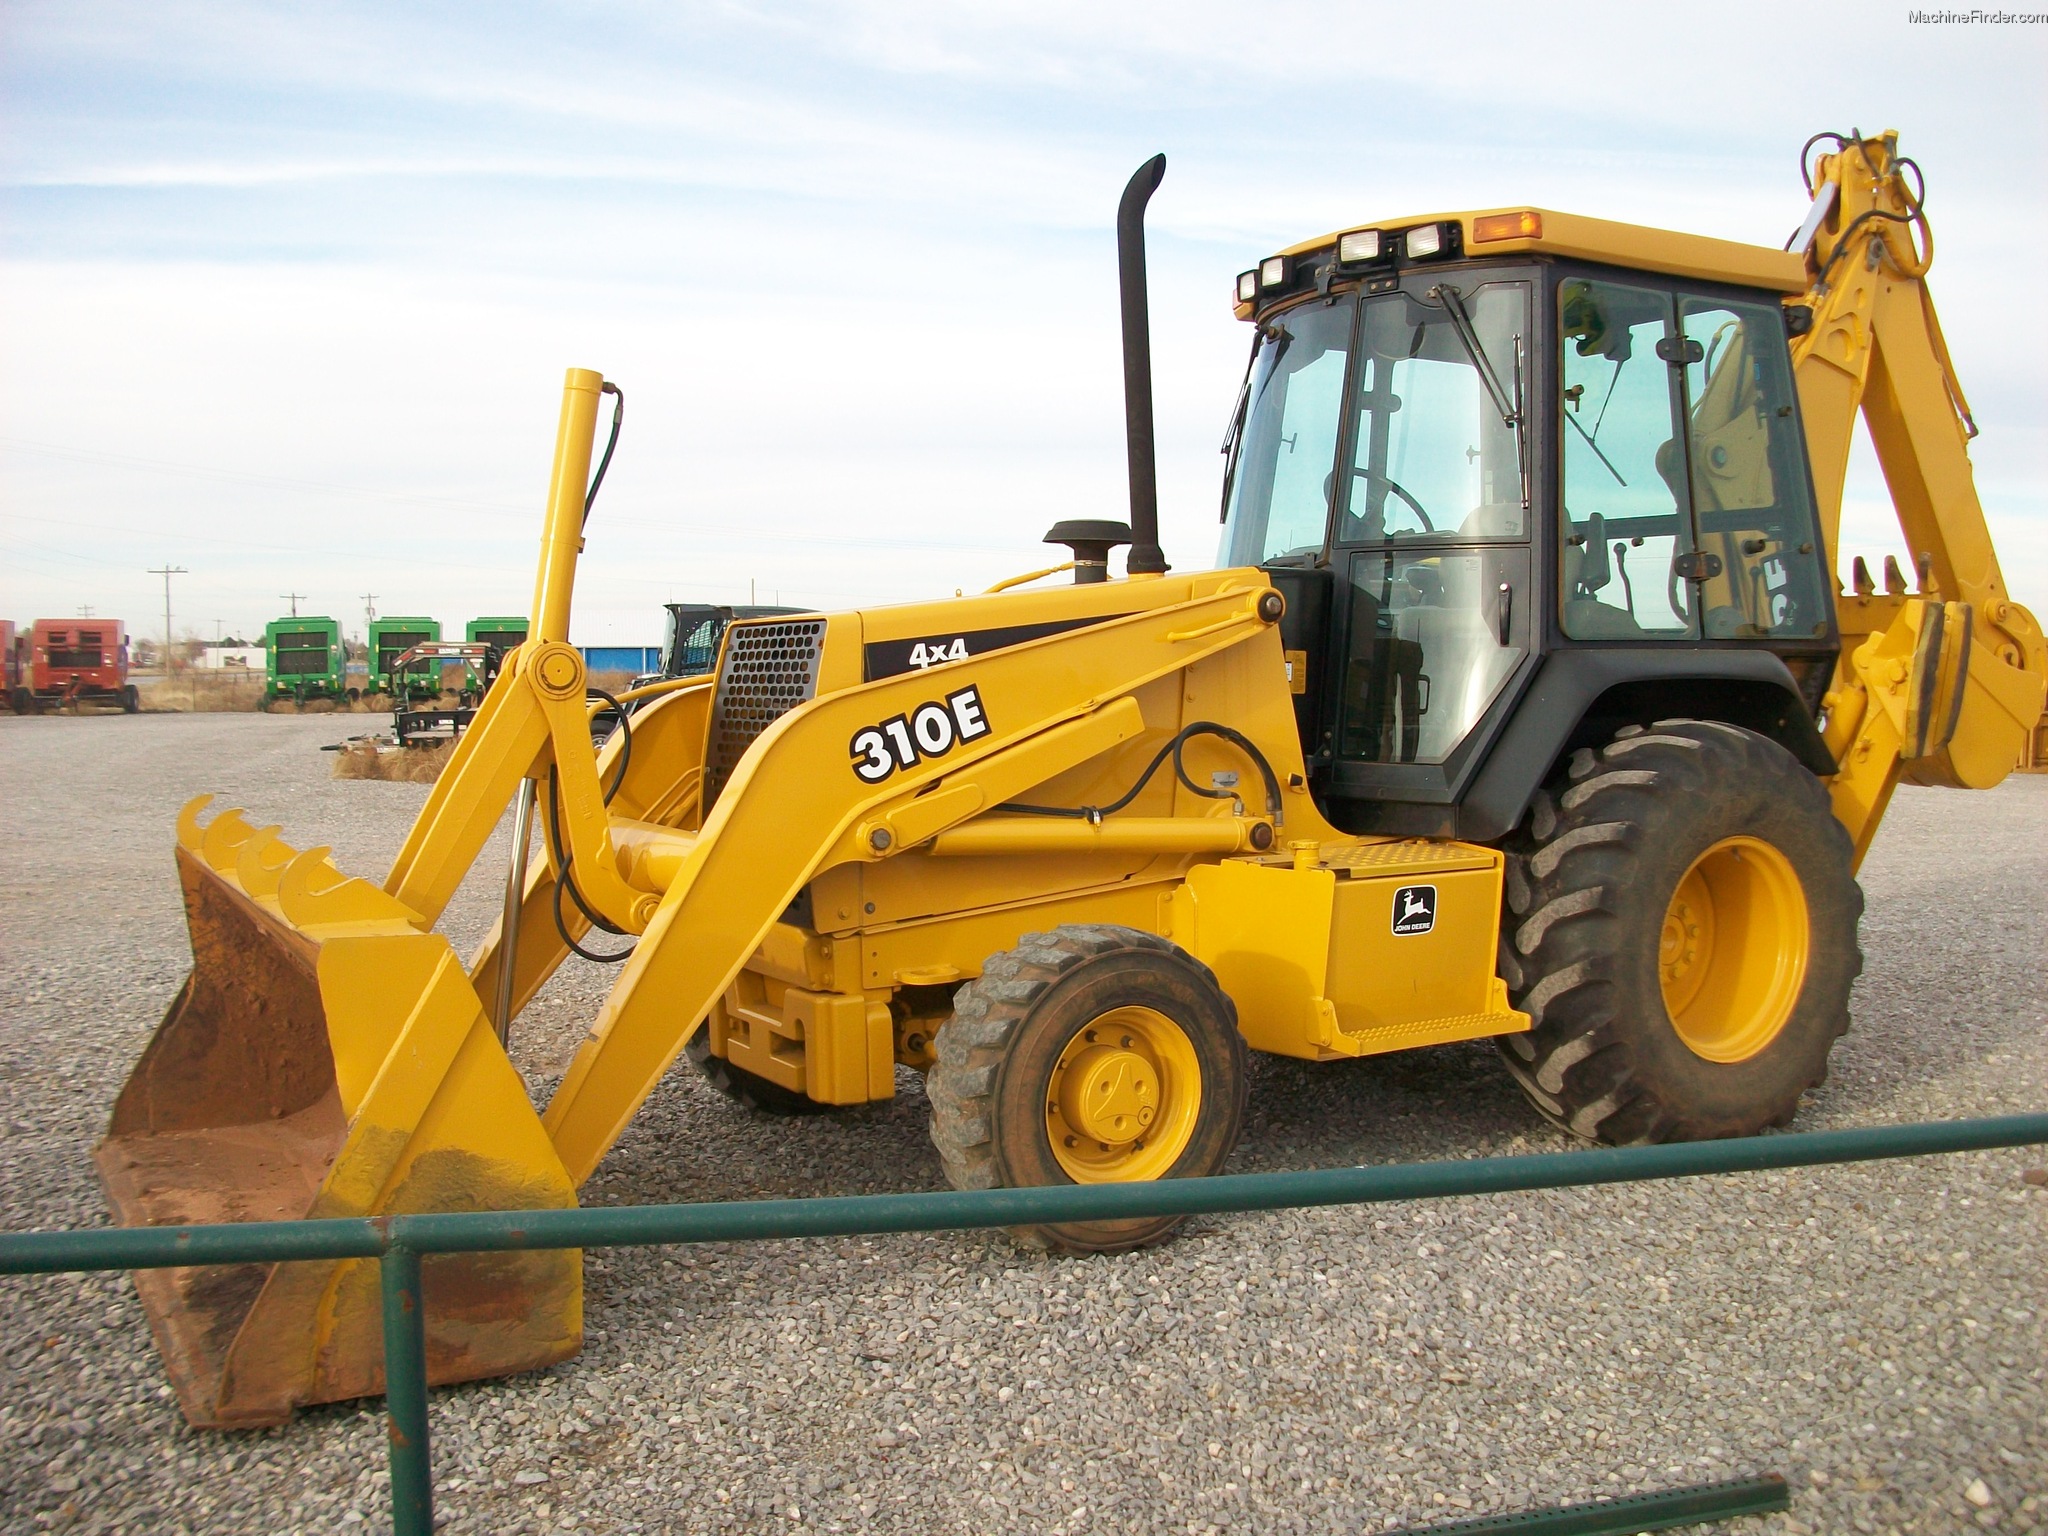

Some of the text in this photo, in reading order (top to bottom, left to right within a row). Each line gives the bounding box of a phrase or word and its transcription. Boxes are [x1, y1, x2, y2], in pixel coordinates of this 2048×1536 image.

[908, 637, 969, 670] 4x4
[851, 687, 989, 781] 310E
[1411, 922, 1431, 930] DEERE
